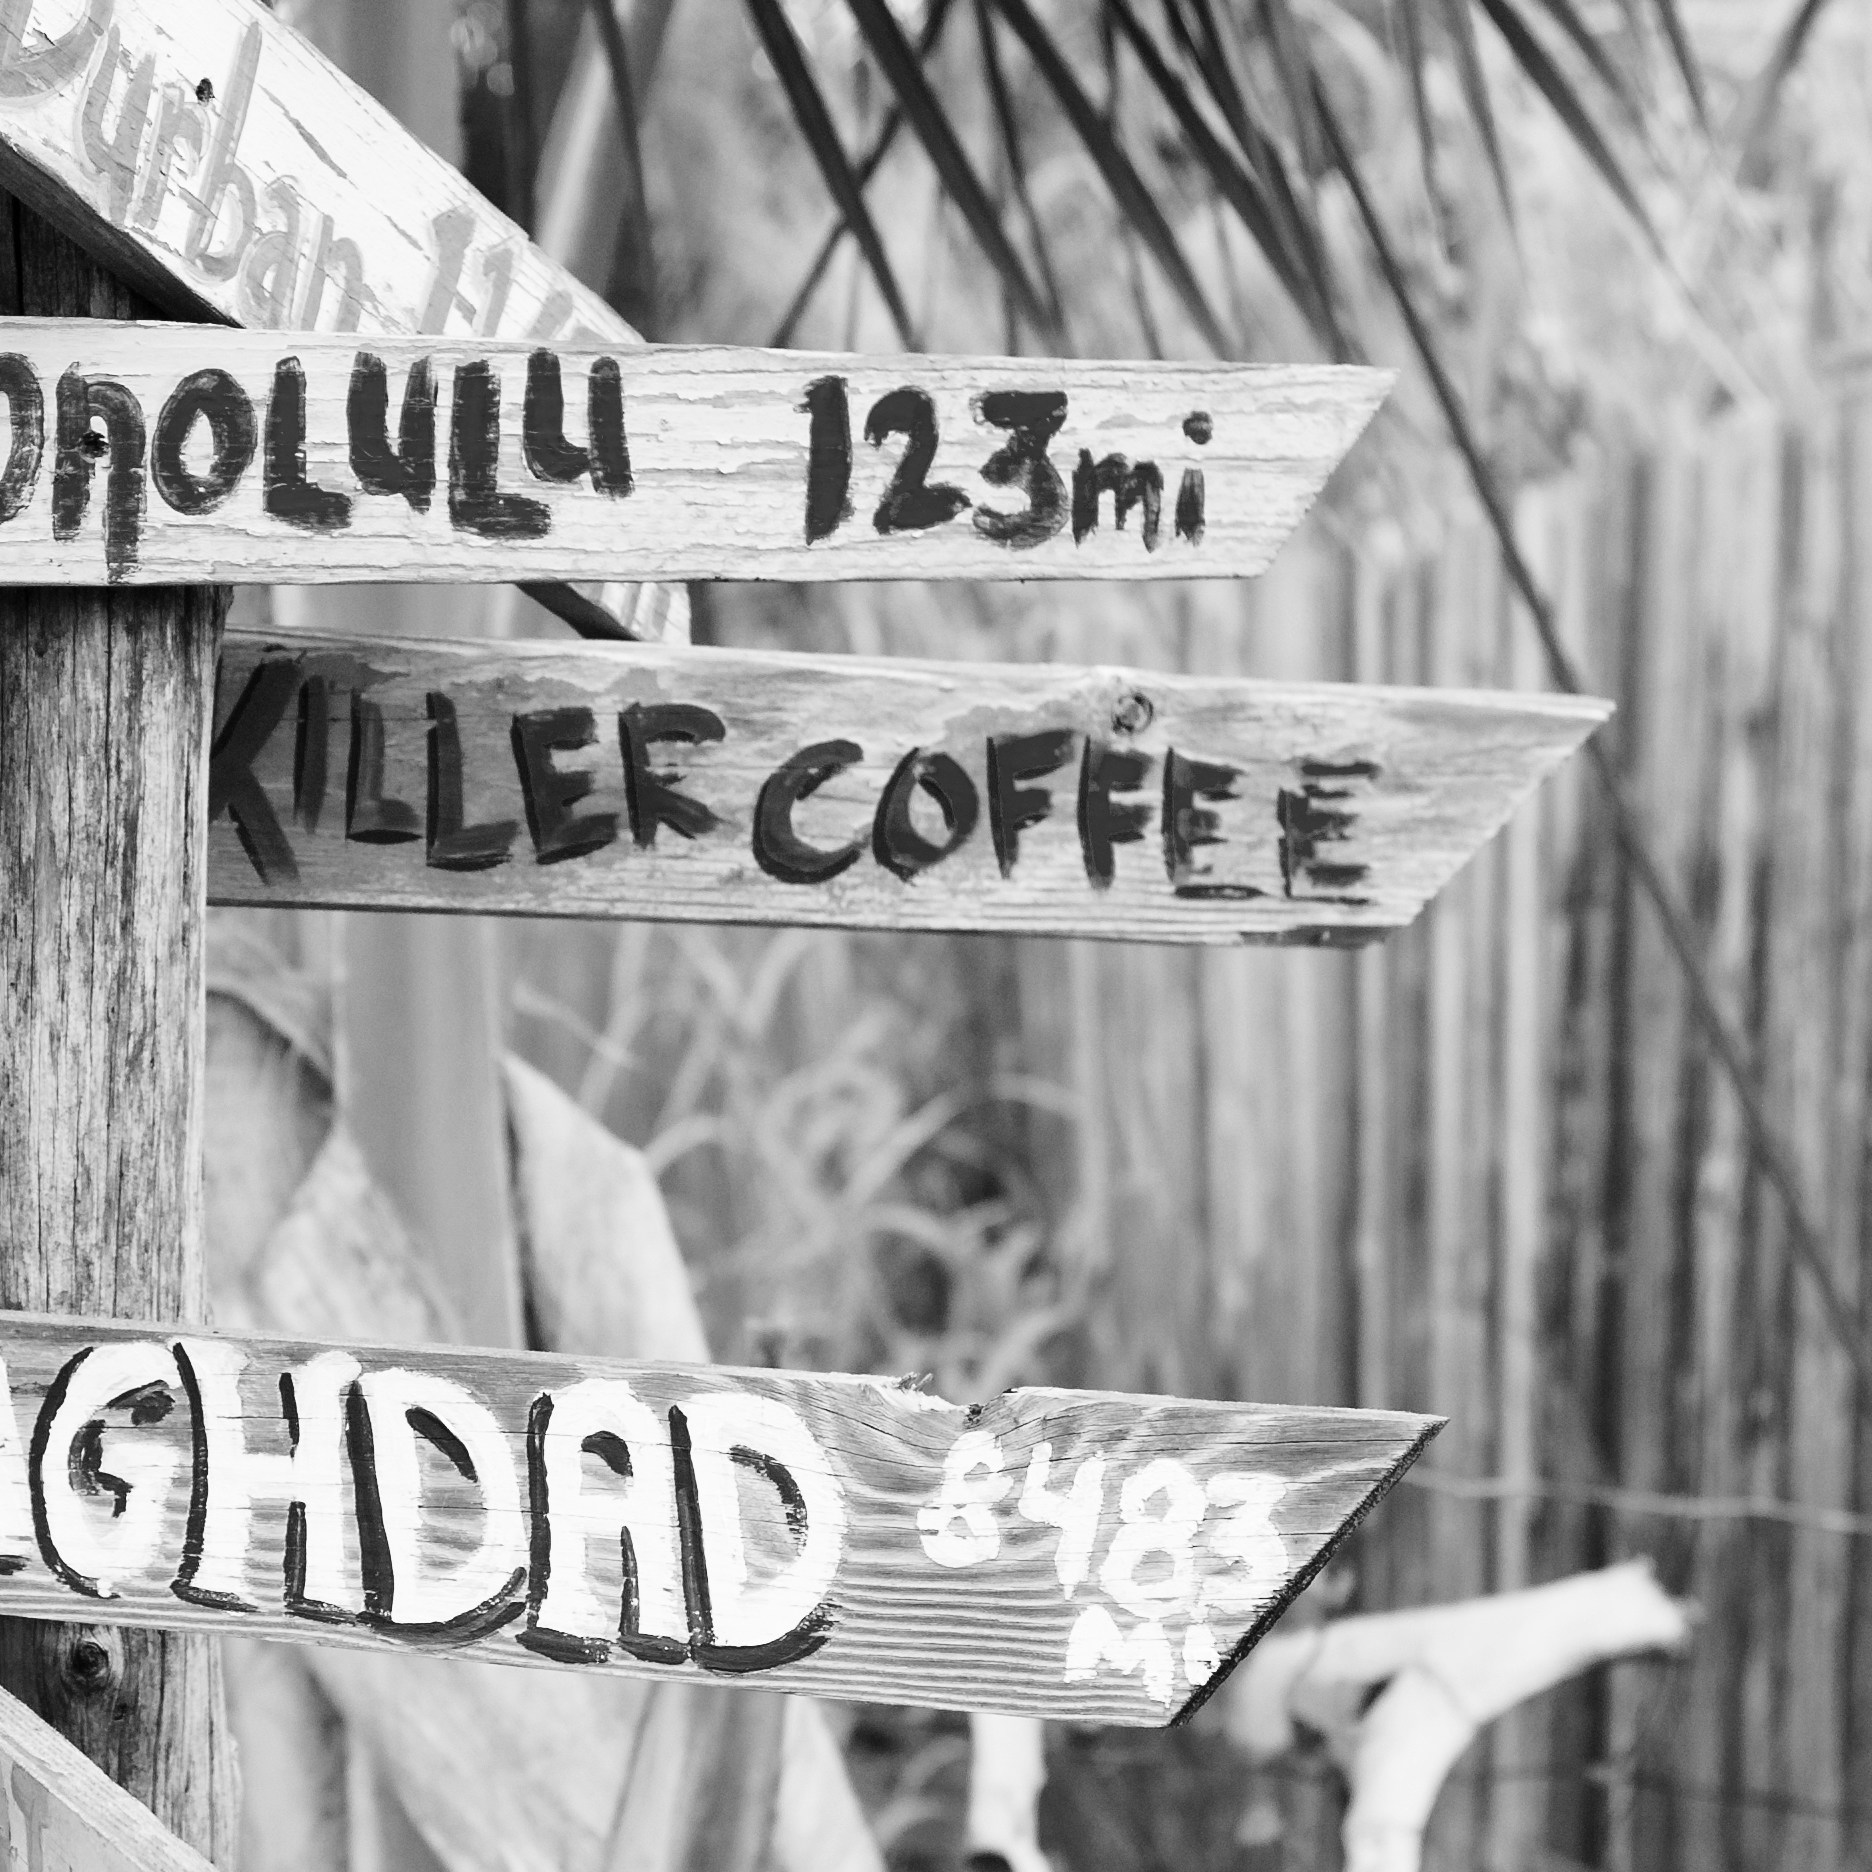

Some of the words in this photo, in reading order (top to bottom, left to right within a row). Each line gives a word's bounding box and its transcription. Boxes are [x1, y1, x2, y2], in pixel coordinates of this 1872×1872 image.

[211, 650, 728, 886] KILLER
[751, 728, 1380, 906] COFFEE
[916, 1430, 1291, 1622] 8483
